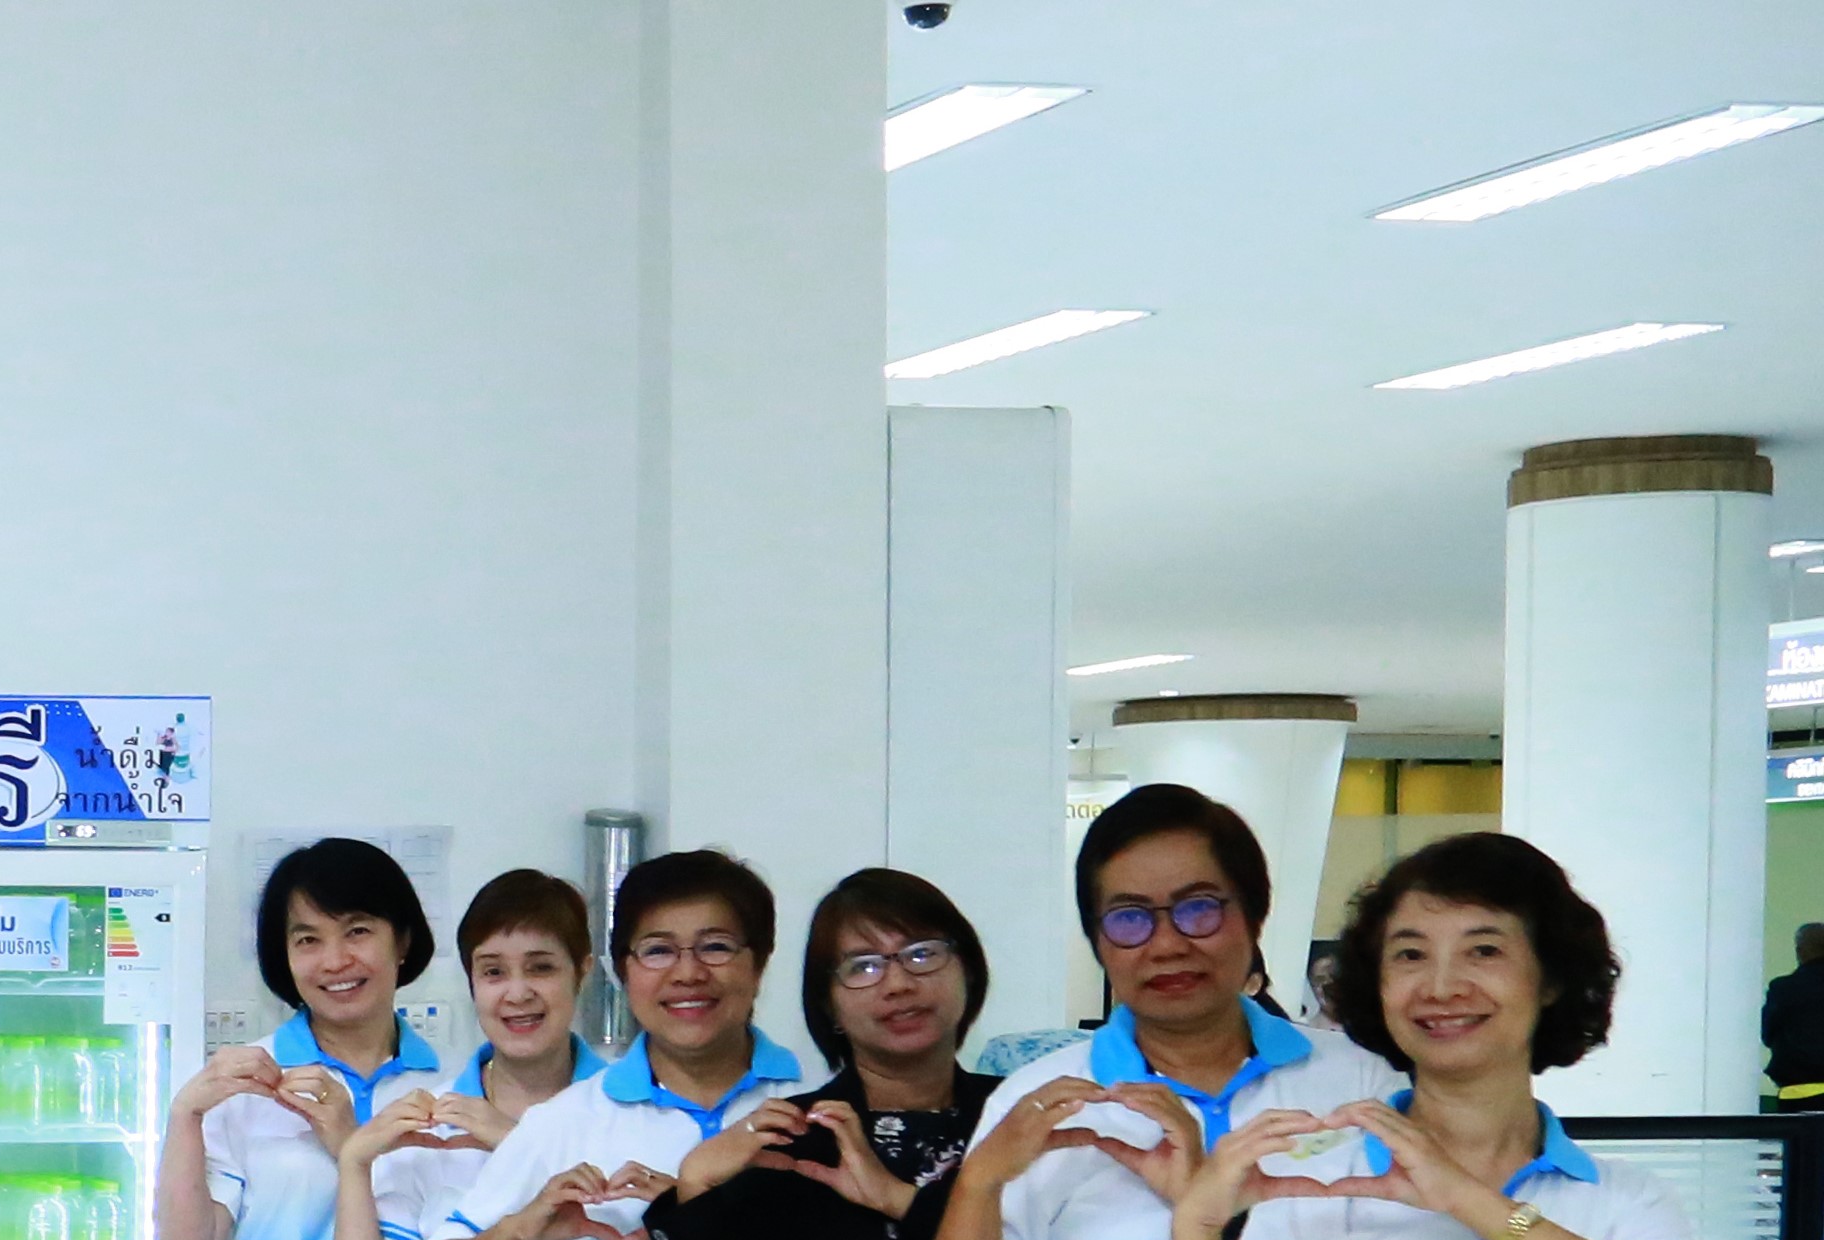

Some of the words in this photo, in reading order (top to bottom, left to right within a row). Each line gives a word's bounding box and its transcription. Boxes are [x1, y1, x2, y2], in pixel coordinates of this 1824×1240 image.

[74, 726, 163, 770] น้ำดื่ม
[56, 770, 184, 814] จากน้ำใจ
